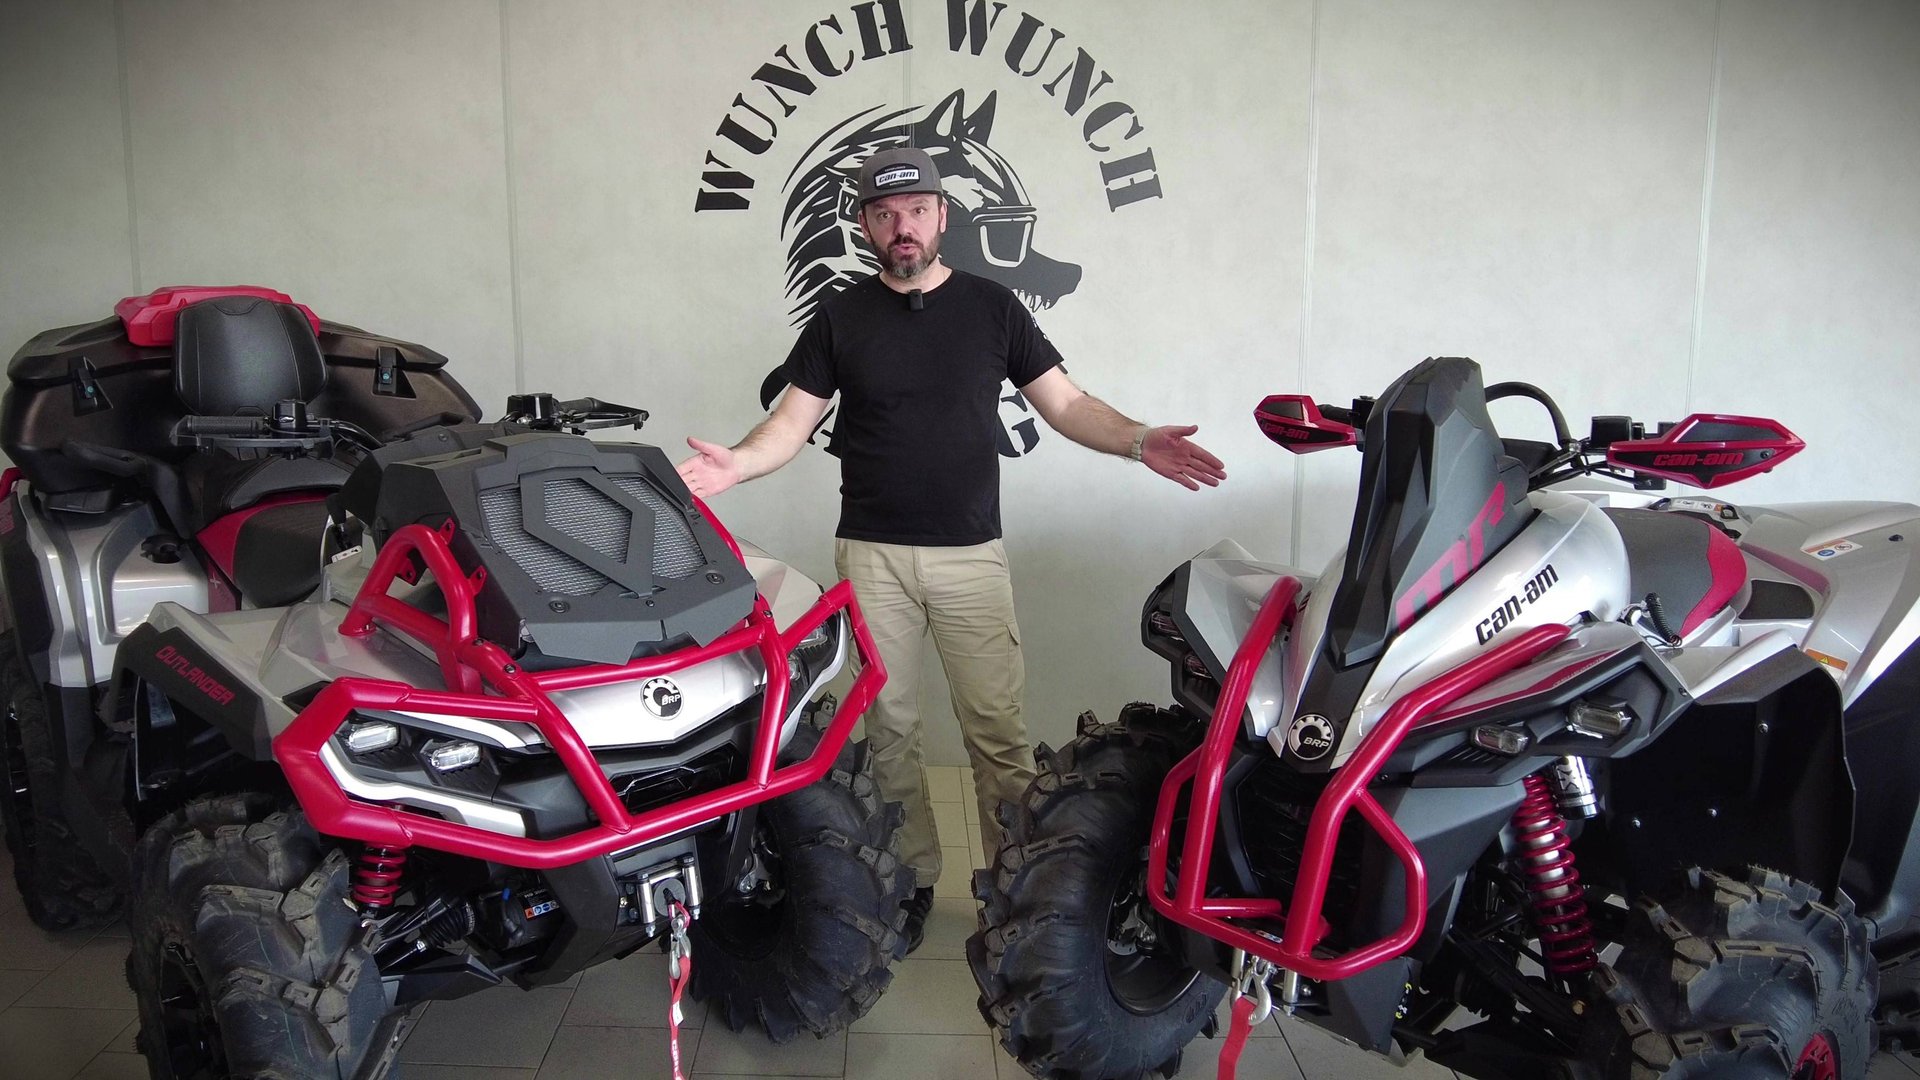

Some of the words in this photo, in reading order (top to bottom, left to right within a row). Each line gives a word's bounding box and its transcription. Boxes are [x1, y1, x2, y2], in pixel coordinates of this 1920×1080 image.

[695, 0, 913, 212] WUNCH
[946, 0, 1163, 212] WUNCH
[878, 171, 916, 183] can-am
[1262, 422, 1310, 440] can-am
[1653, 452, 1744, 466] can-am
[1475, 564, 1559, 646] can-am
[155, 645, 236, 705] OUTLANDER
[661, 693, 681, 706] BRP
[1303, 736, 1330, 748] BRP
